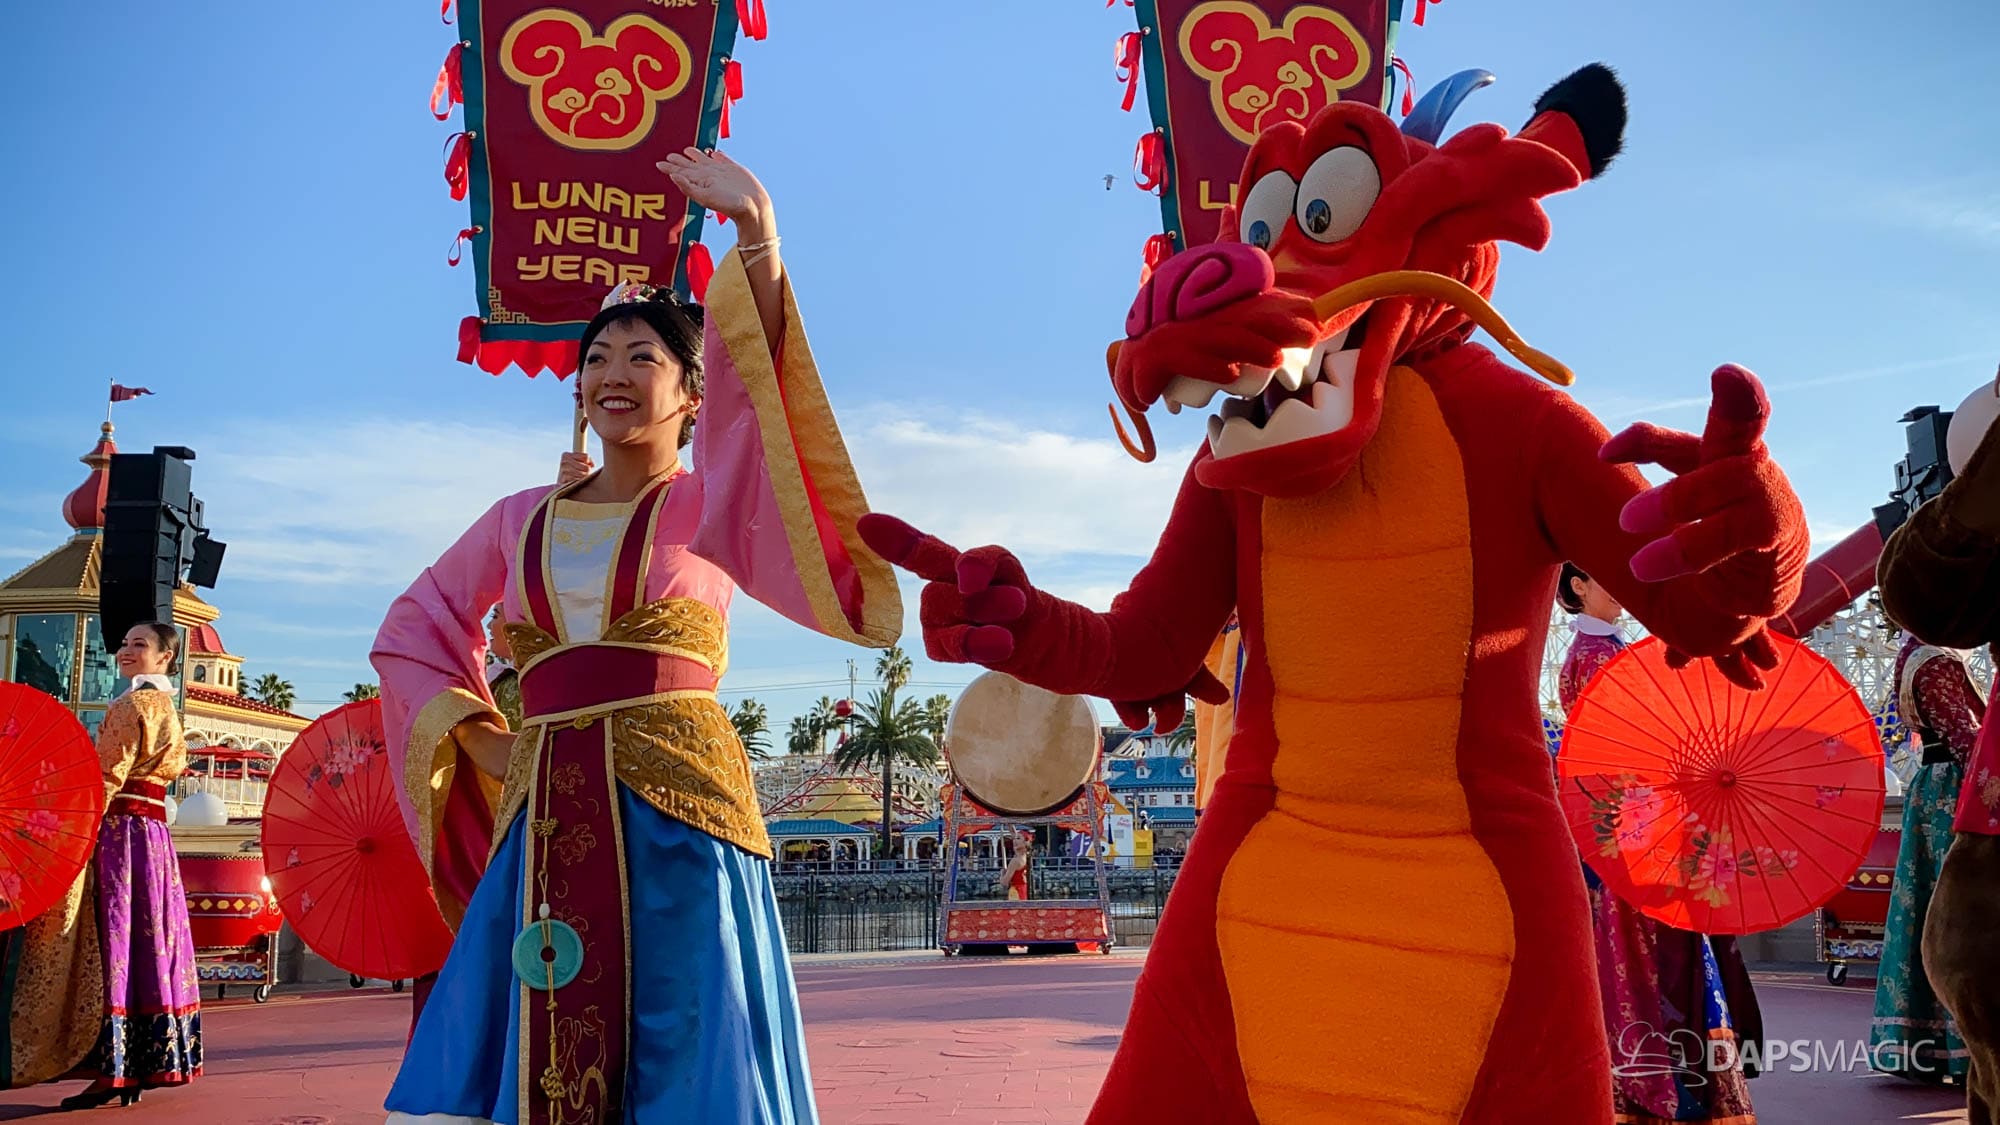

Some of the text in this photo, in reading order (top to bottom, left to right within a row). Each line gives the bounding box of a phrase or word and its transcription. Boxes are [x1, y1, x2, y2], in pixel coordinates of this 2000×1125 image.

[511, 182, 666, 220] LUNAR
[534, 217, 639, 255] NEW
[517, 255, 650, 287] YEAR
